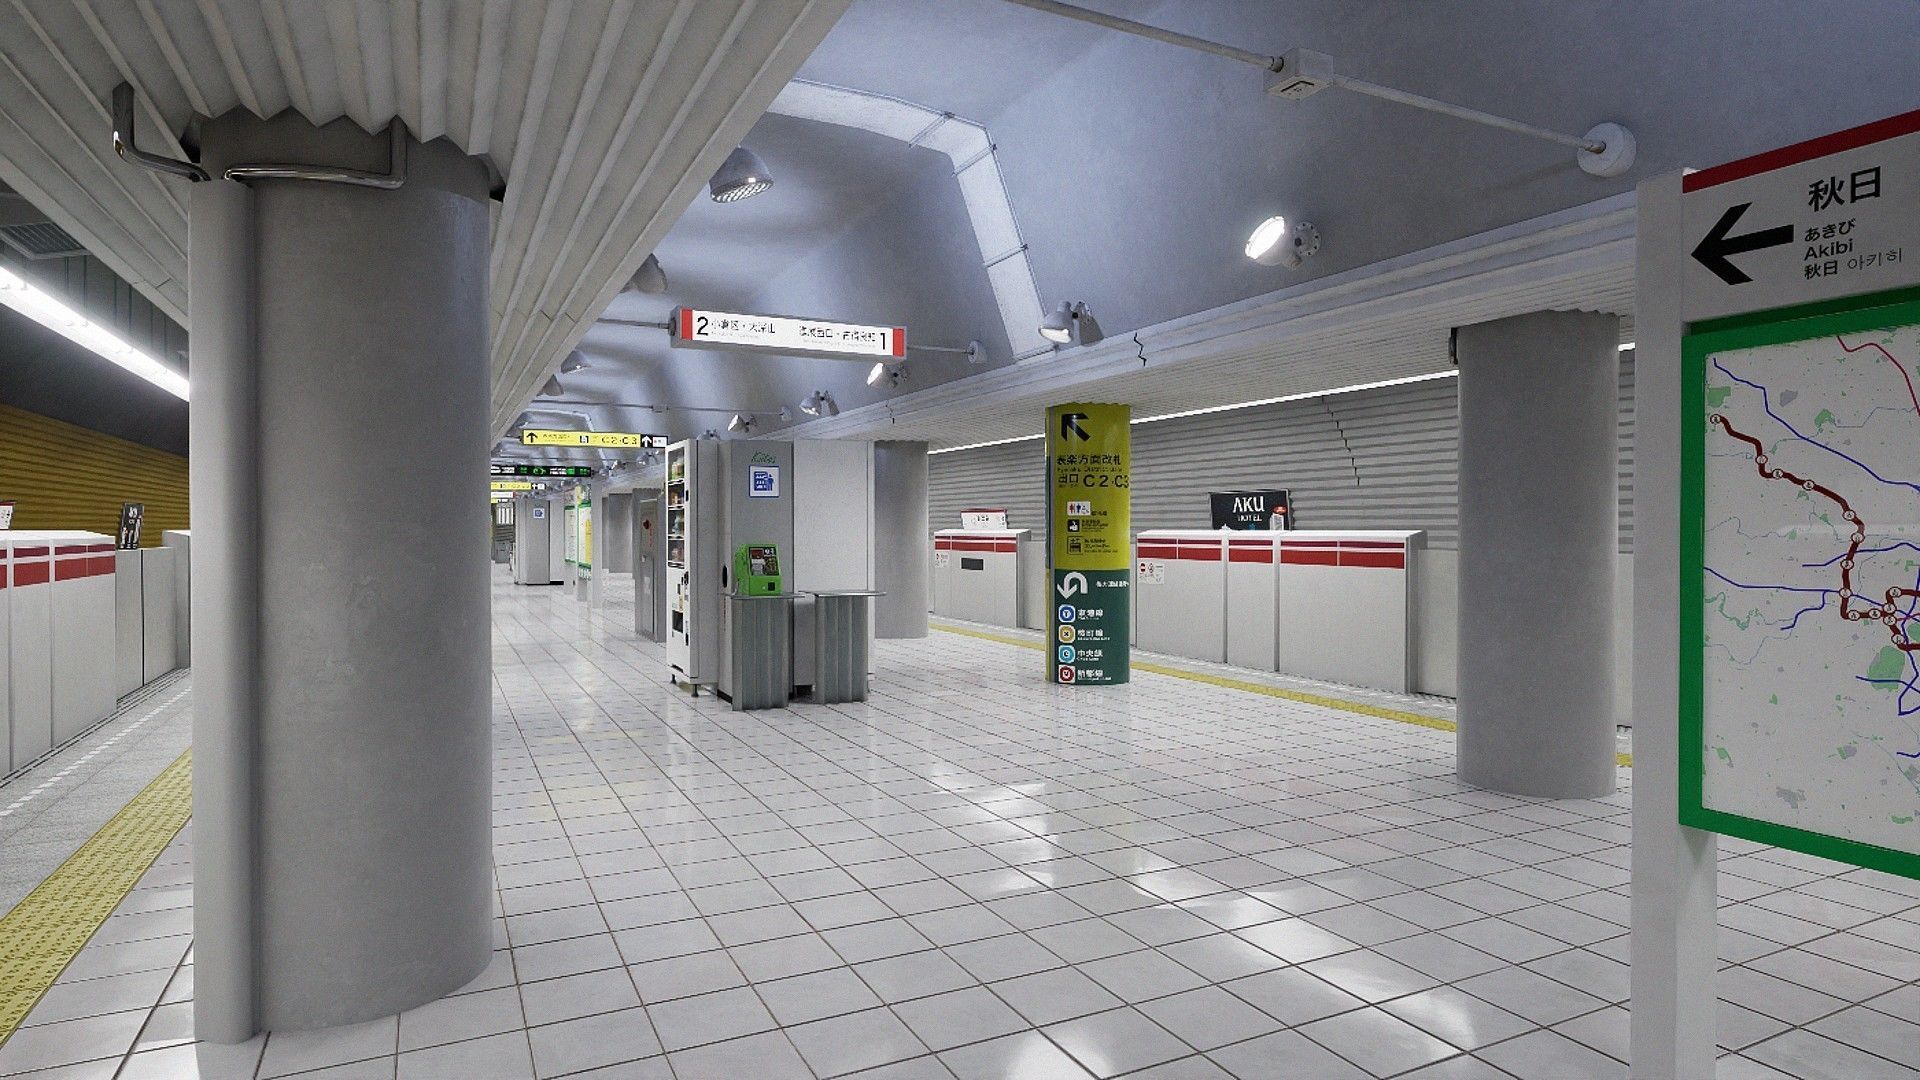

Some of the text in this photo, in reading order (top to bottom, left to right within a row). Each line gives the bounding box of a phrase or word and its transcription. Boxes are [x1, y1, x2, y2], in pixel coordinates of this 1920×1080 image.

[1808, 165, 1881, 212] 秋日
[1804, 217, 1856, 242] あきび
[1804, 238, 1854, 261] Akibi
[1804, 260, 1838, 280] 秋日
[696, 316, 709, 336] 2
[880, 332, 886, 350] 1
[1058, 474, 1079, 484] 出口
